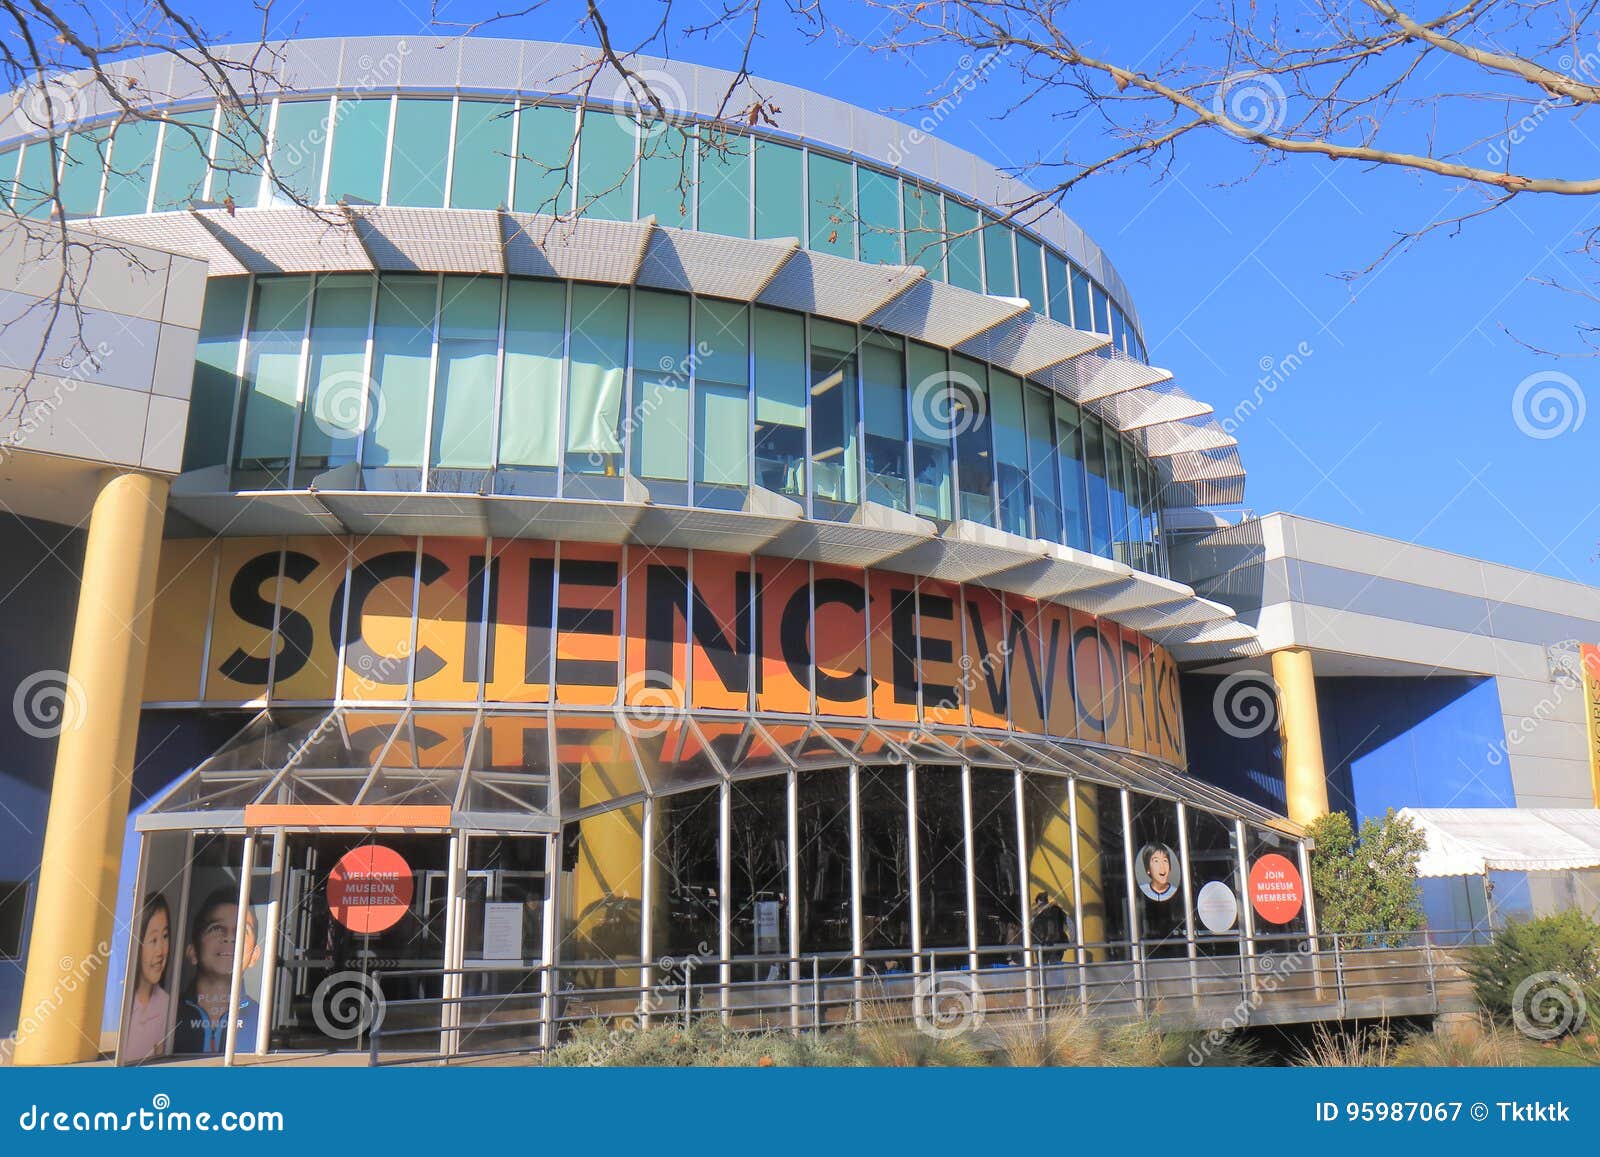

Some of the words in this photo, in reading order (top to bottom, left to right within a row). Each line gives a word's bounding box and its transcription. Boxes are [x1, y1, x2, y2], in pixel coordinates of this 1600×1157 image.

[218, 549, 1184, 757] SCIENCEWORKS
[342, 872, 399, 881] WELCOME
[1265, 871, 1285, 880] JOIN
[345, 884, 395, 893] MUSEUM
[1257, 882, 1294, 891] MUSEUM
[342, 896, 397, 905] MEMBERS
[1256, 893, 1297, 902] MEMBERS
[190, 1019, 244, 1029] WONDR
